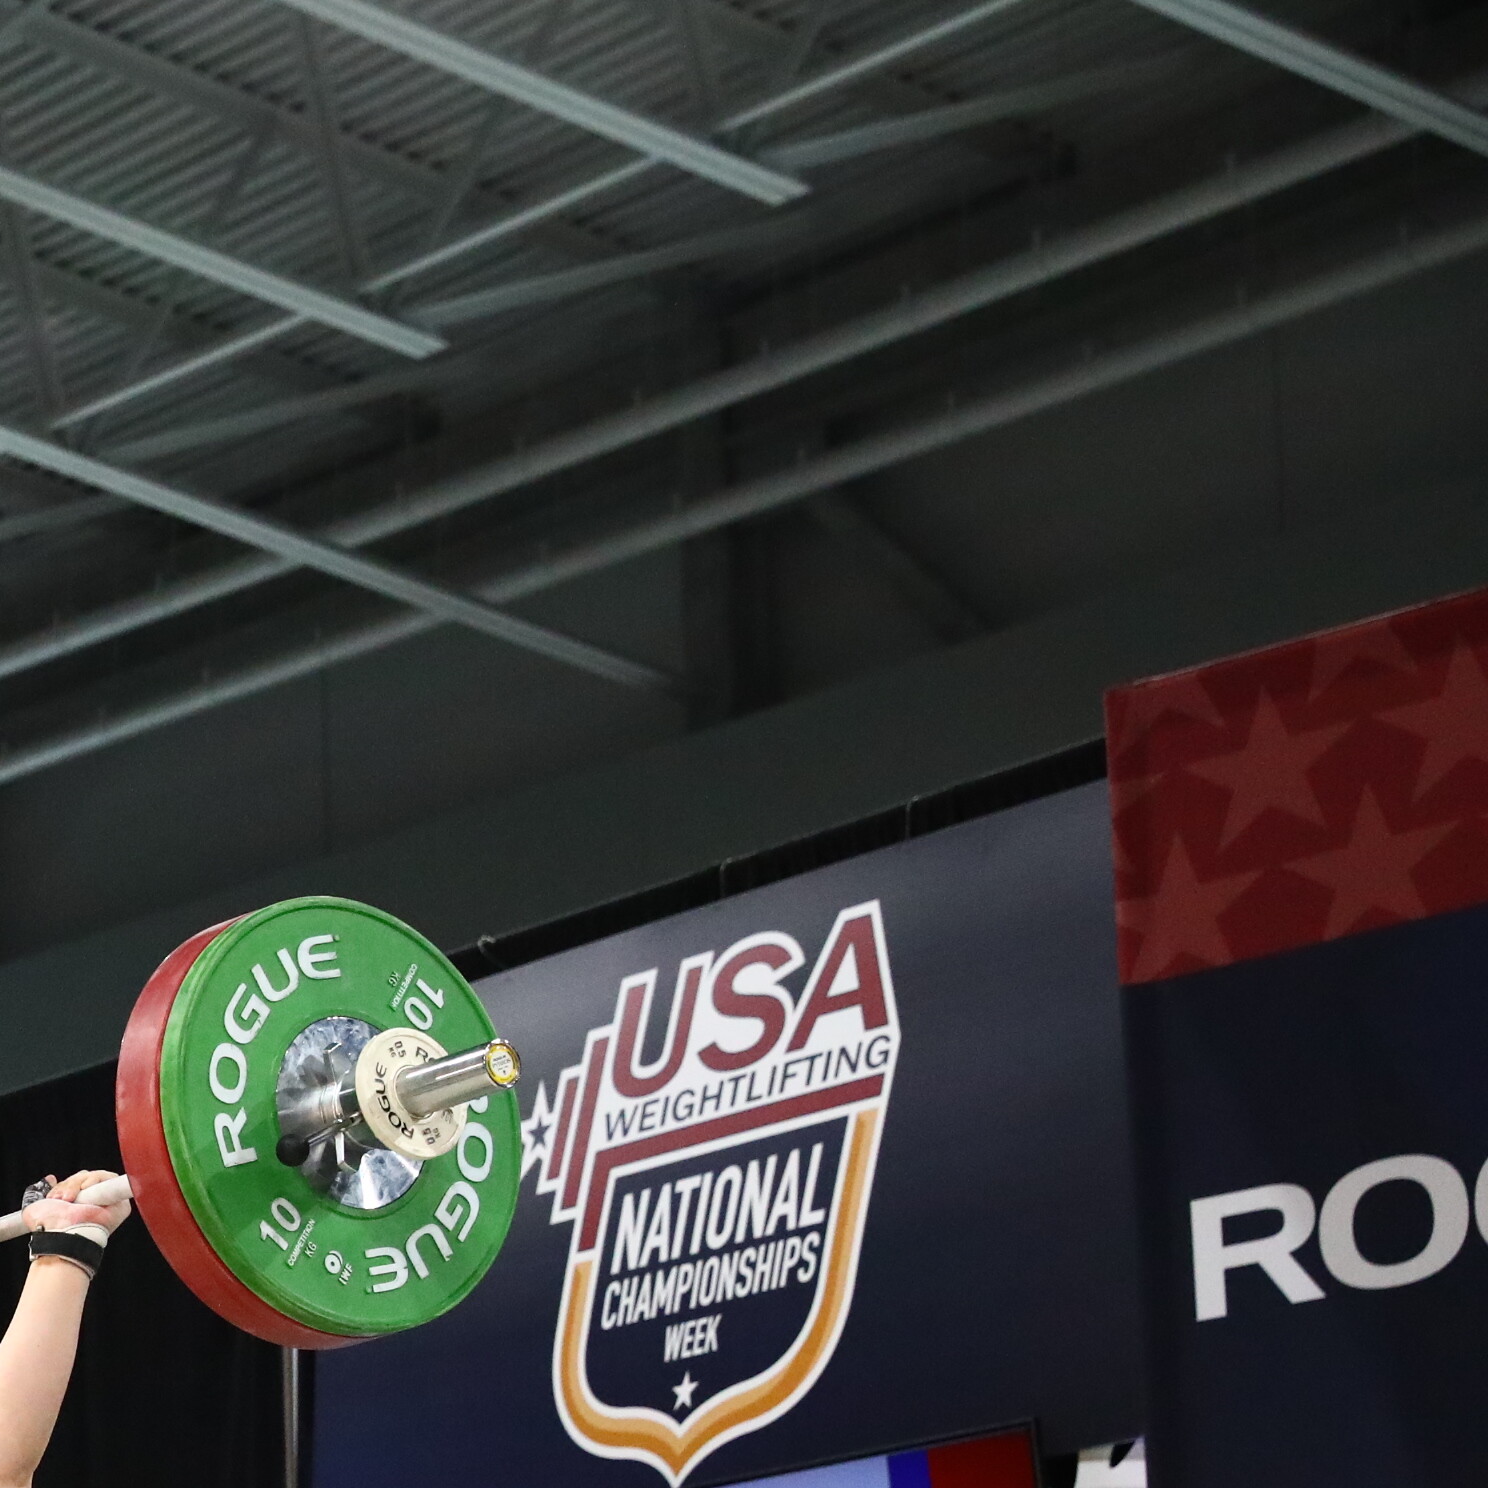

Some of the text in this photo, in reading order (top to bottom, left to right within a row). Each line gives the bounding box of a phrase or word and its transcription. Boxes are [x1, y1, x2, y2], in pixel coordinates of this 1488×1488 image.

[390, 963, 418, 1009] COMPETITION
[403, 978, 445, 1031] 10
[612, 912, 890, 1098] USA
[208, 934, 342, 1168] ROGUE
[373, 1061, 415, 1140] ROGUE
[604, 1033, 893, 1142] WEIGHTLIFTING
[259, 1197, 301, 1251] 10
[610, 1141, 826, 1276] NATIONAL
[1189, 1152, 1488, 1323] RO
[287, 1218, 316, 1267] COMPETITION
[304, 1241, 317, 1258] KG
[338, 1263, 354, 1286] IWF
[600, 1232, 821, 1331] CHAMPIONSHIPS
[663, 1314, 723, 1364] WEEK
